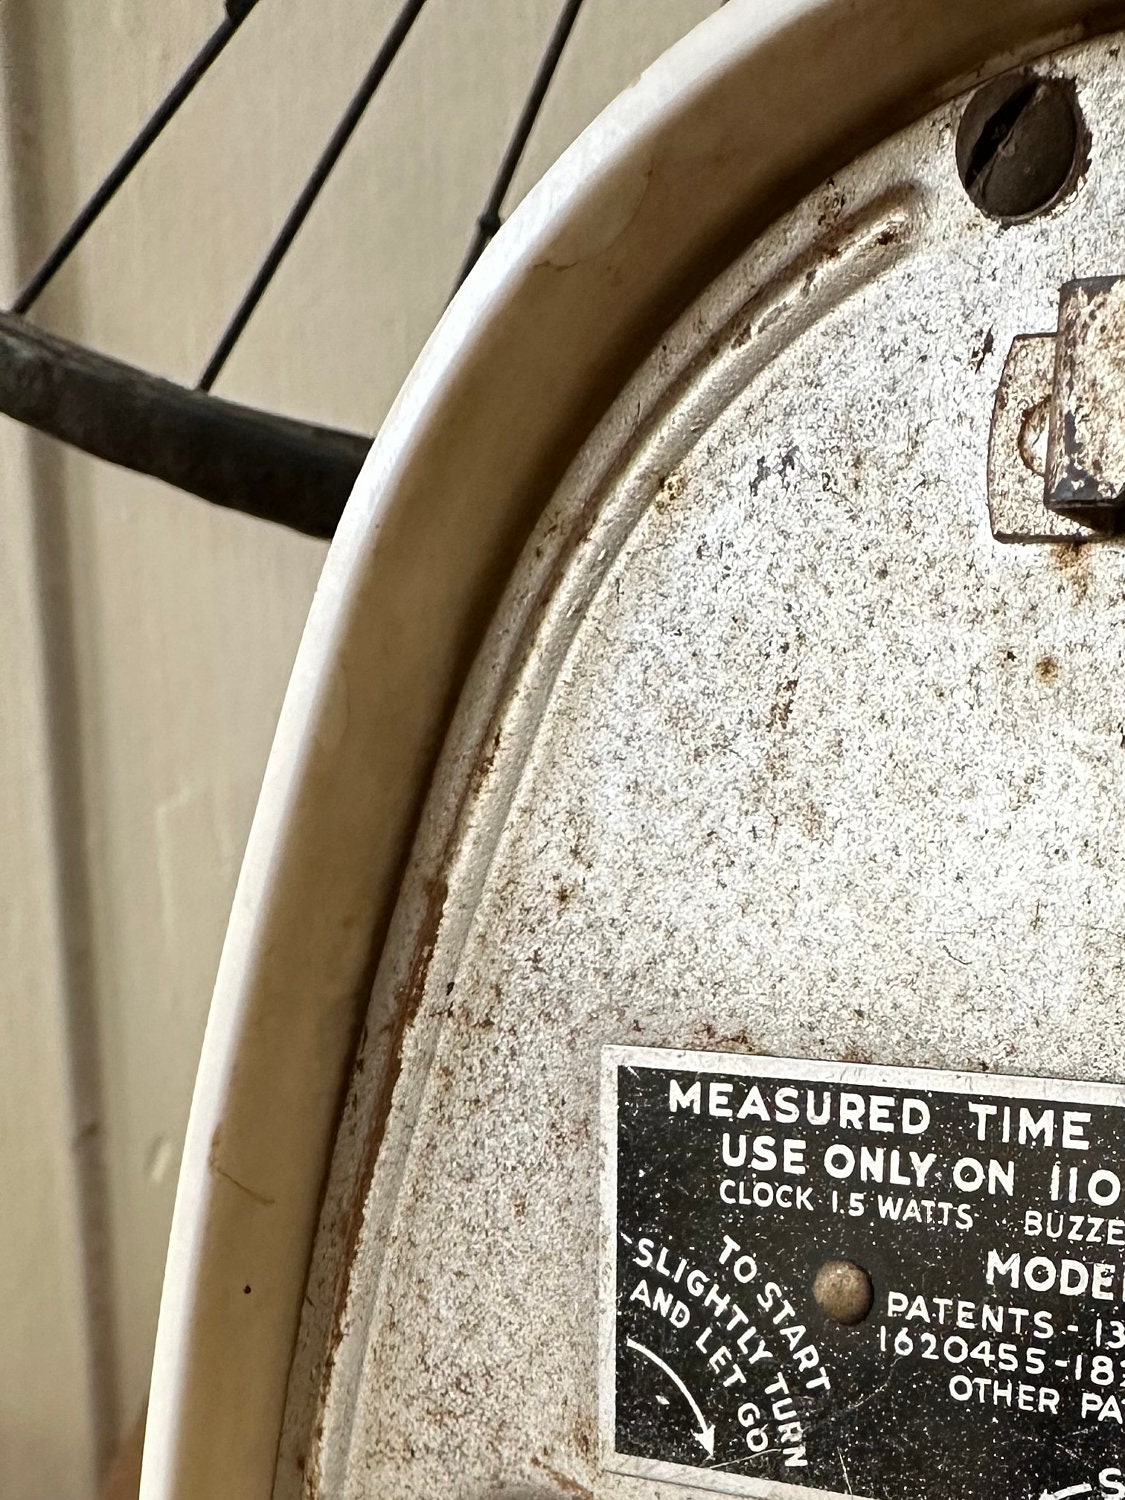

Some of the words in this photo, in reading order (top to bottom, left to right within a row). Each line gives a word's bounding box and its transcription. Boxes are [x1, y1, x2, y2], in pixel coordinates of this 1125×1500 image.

[669, 1079, 931, 1135] MEASURED
[968, 1101, 1091, 1150] TIME
[719, 1180, 814, 1211] CLOCK
[831, 1190, 865, 1217] 1.5
[877, 1195, 974, 1231] WATTS
[722, 1133, 807, 1175] USE
[824, 1144, 937, 1188] ONLY
[953, 1157, 1015, 1197] ON
[1050, 1163, 1121, 1206] 110
[718, 1234, 758, 1284] TO
[756, 1281, 831, 1391] START
[629, 1279, 690, 1329] AND
[695, 1326, 747, 1388] LET
[737, 1401, 769, 1453] GO
[632, 1237, 774, 1366] SLIGHTLY
[763, 1371, 808, 1468] TURN
[949, 1375, 1060, 1416] OTHER
